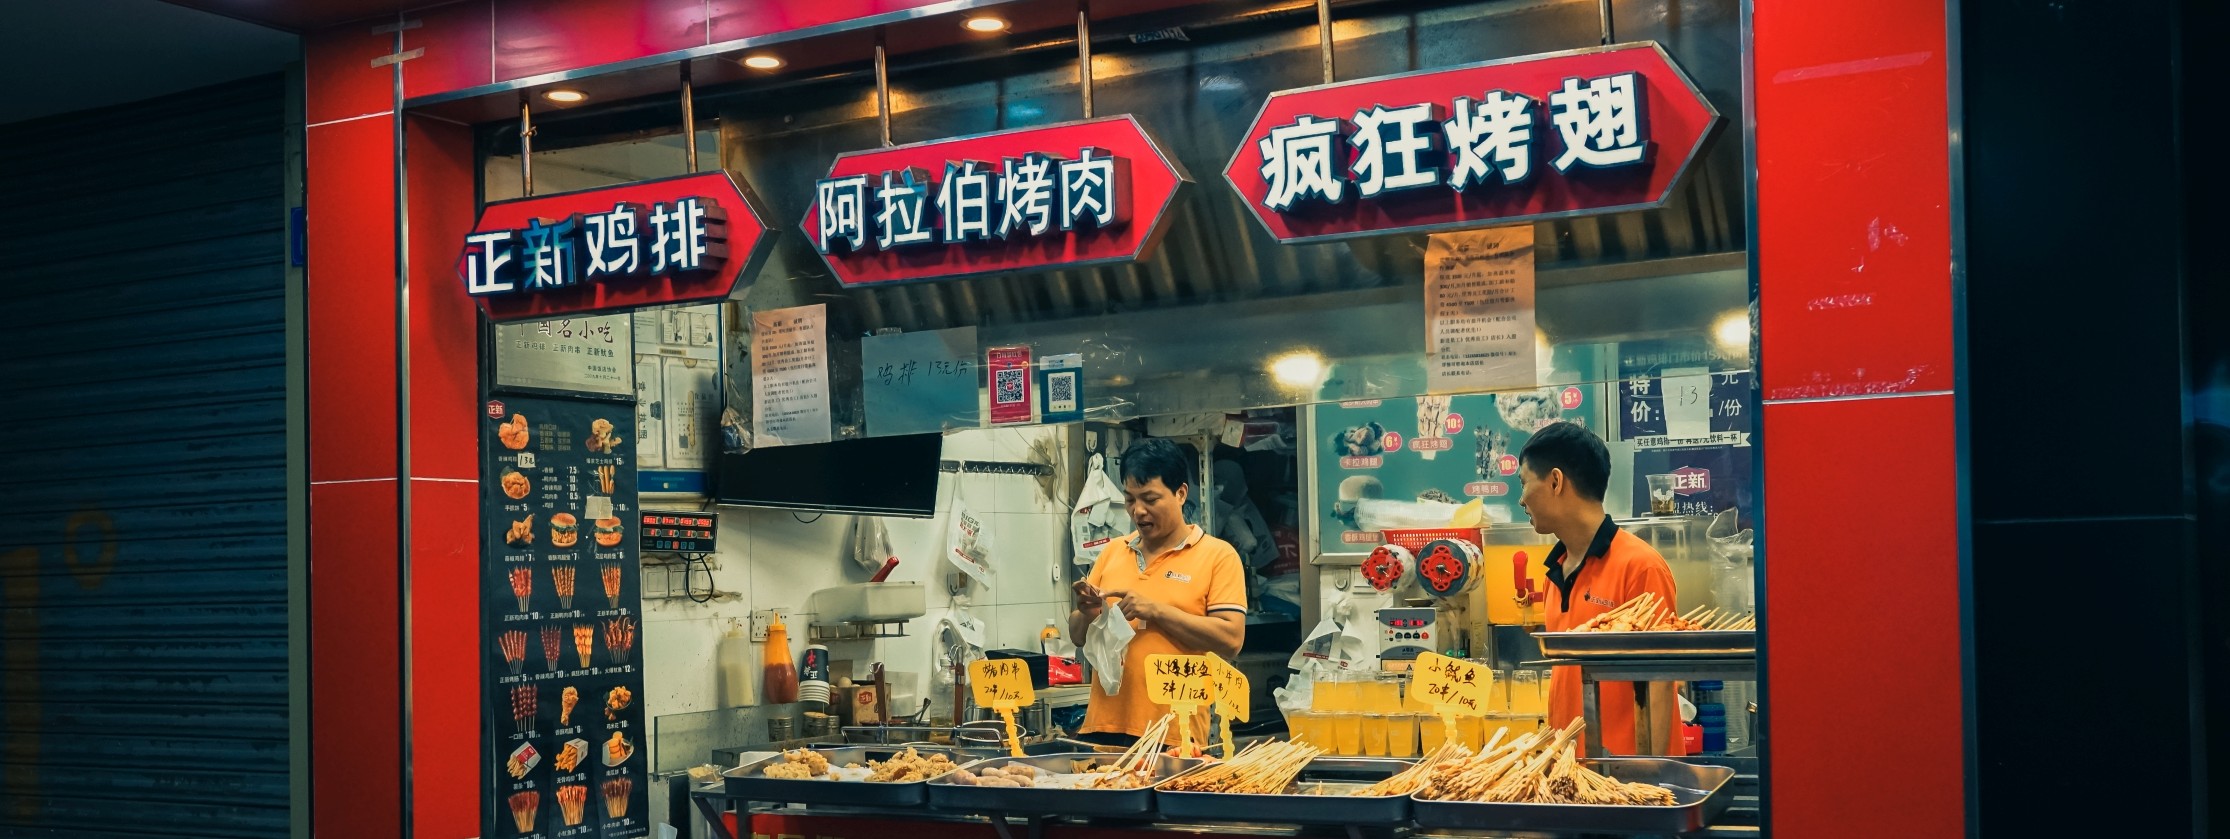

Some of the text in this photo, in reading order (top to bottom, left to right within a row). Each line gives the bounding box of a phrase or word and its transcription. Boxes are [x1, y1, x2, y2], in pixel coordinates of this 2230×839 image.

[1261, 73, 1645, 211] 疯狂烤翅
[818, 149, 1115, 253] 阿拉伯烤肉
[466, 199, 708, 296] 正新鸡排
[552, 344, 581, 354] 正新肉串
[587, 347, 614, 357] 正新鱿鱼
[877, 359, 918, 386] 鸡排
[1629, 368, 1739, 396] 特 元
[1564, 391, 1571, 404] 5
[1679, 385, 1699, 407] 13
[488, 405, 504, 415] 正新
[1446, 418, 1456, 428] 10
[1385, 435, 1393, 448] 6
[1412, 439, 1449, 450] 疯狂烤翅
[1343, 457, 1379, 468] 卡拉鸡腿
[1500, 459, 1512, 469] 10
[1674, 472, 1705, 489] 正新
[1153, 658, 1213, 678] 火爆鱿鱼
